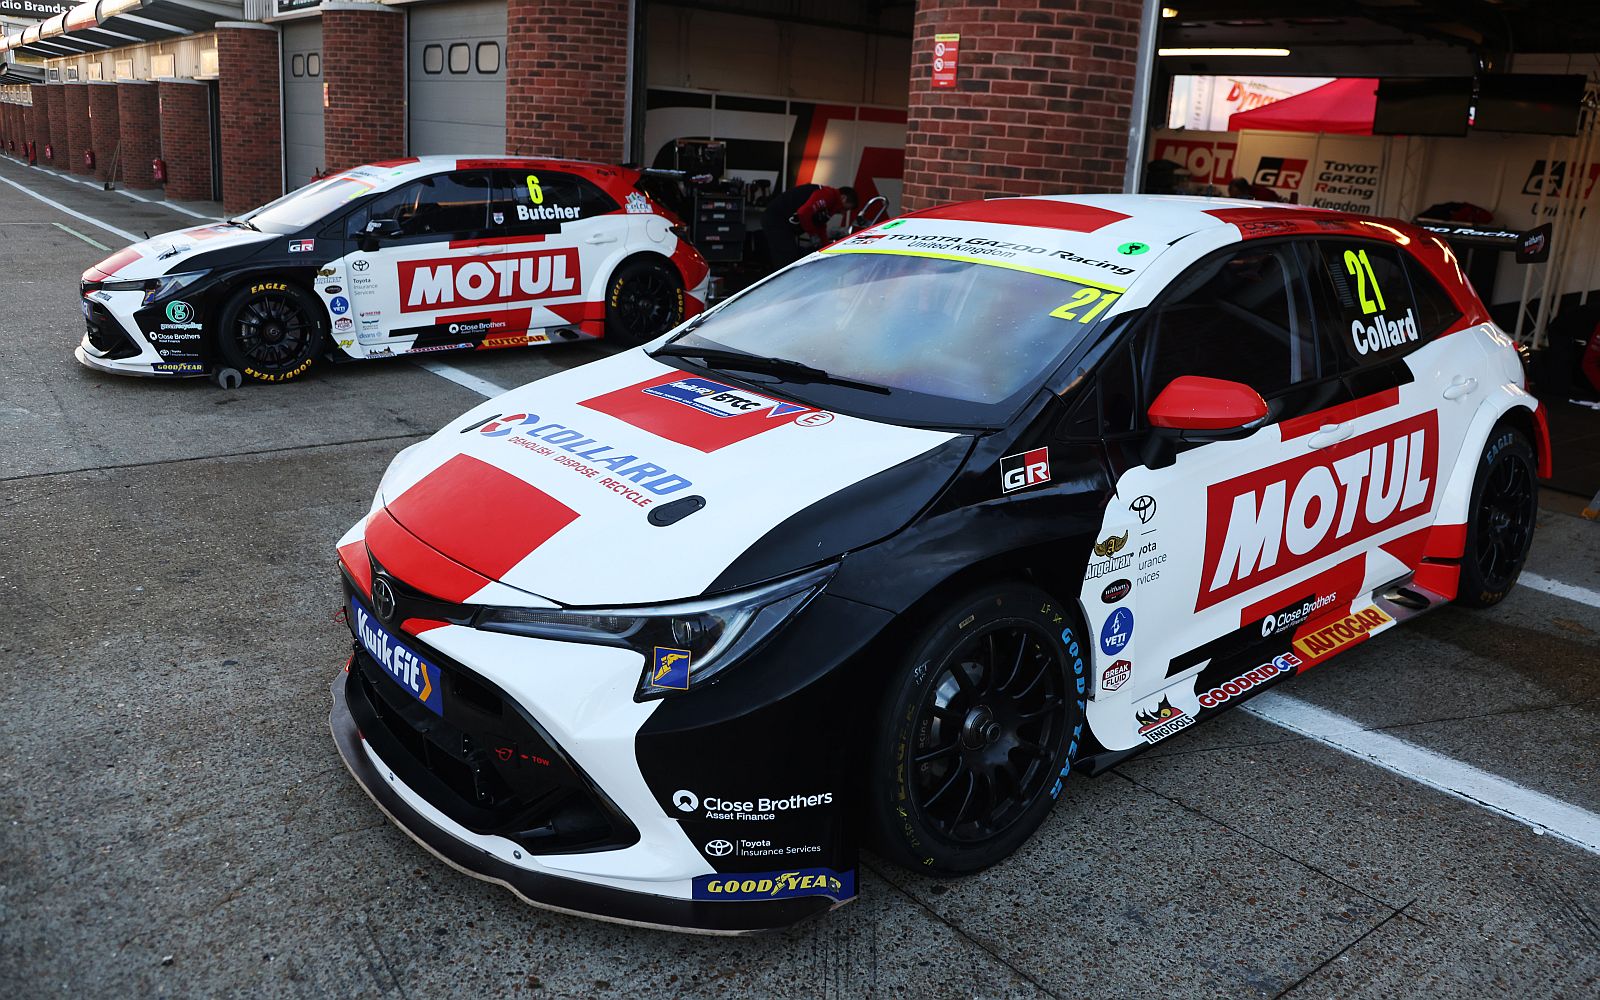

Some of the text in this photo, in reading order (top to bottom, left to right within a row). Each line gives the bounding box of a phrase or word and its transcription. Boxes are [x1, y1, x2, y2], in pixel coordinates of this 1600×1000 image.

[0, 0, 22, 10] dio
[24, 1, 67, 14] Brands
[1323, 160, 1379, 175] TOYOT
[1255, 168, 1302, 188] GR
[526, 174, 544, 204] 6
[1314, 183, 1374, 200] Racing
[516, 203, 580, 221] Butcher
[1312, 197, 1371, 214] Kingdom
[887, 233, 1137, 276] TOYOTA GAZOO Racing
[907, 240, 1017, 259] United Kingdom
[250, 282, 288, 295] EAGLE
[407, 254, 576, 307] MOTUL
[1343, 249, 1387, 315] 21
[1048, 286, 1121, 325] 21
[460, 323, 479, 332] Close
[478, 321, 507, 331] Brothers
[1351, 307, 1419, 356] Collard
[487, 334, 546, 347] AUTOCAR
[157, 363, 203, 372] GOODYEAR
[710, 392, 763, 411] BTCC
[1486, 432, 1514, 465] EAGLE
[525, 422, 694, 496] COLLARD
[506, 435, 653, 508] DEMOLISH DISPOSE RECYCLE
[1003, 461, 1049, 490] GR
[1208, 428, 1431, 593] MOTUL
[1084, 553, 1133, 581] Angelwax
[1138, 553, 1168, 571] urance
[1136, 570, 1160, 587] rvices
[1277, 591, 1337, 628] Close Brothers
[1105, 632, 1127, 647] YETI
[1301, 607, 1388, 656] AUTOCAR
[1105, 663, 1129, 679] BREAK
[1105, 673, 1127, 688] FLUID
[1198, 652, 1303, 709] GOODRIDGE
[531, 754, 552, 767] TOW
[703, 792, 833, 812] Close Brothers
[705, 811, 776, 821] Asset Finance
[740, 839, 771, 849] Toyota
[740, 845, 821, 857] Insurance Services
